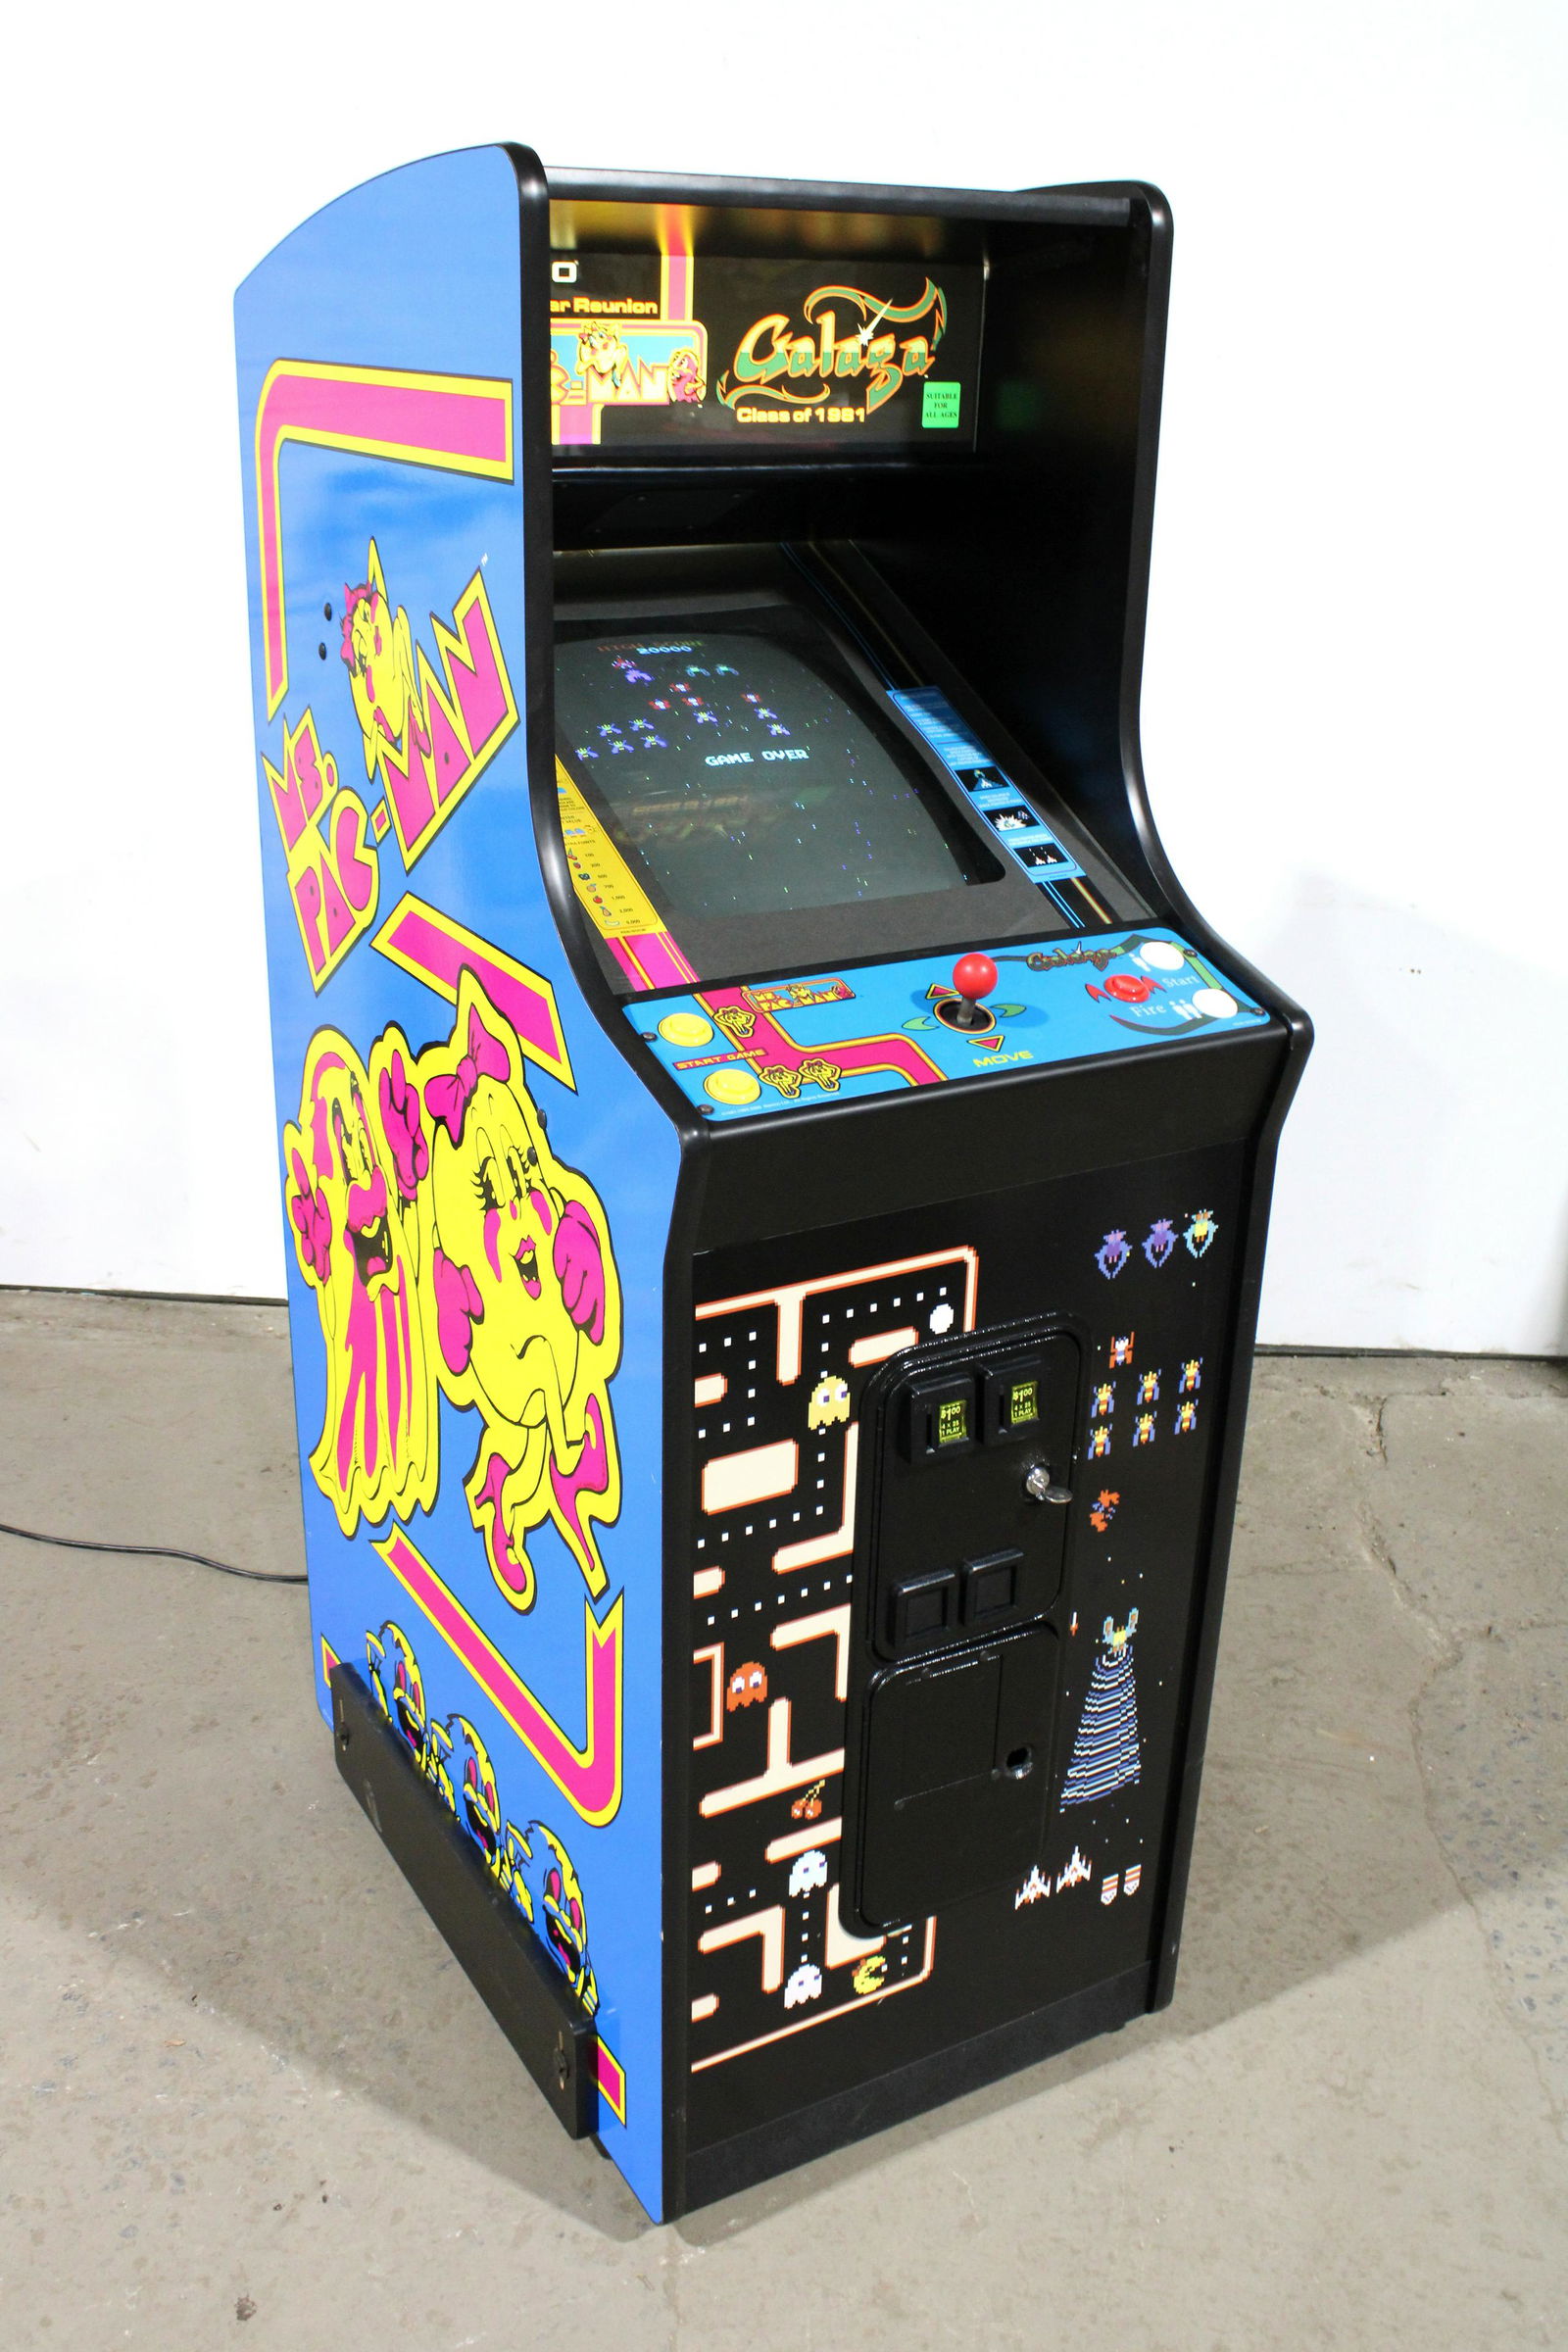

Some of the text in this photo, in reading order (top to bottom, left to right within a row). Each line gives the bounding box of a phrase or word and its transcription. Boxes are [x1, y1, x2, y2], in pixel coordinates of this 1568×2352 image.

[573, 296, 659, 315] Reunion
[734, 309, 936, 416] Galaga
[736, 407, 865, 423] Class of 1981
[635, 645, 693, 656] 20000
[705, 749, 809, 766] GAME OVER
[1161, 974, 1200, 988] Start
[1128, 1004, 1167, 1017] Fire
[676, 1048, 765, 1070] START GAME
[972, 1050, 1034, 1067] MOVE
[1019, 1407, 1032, 1416] PLAY
[946, 1426, 960, 1436] PLAY
